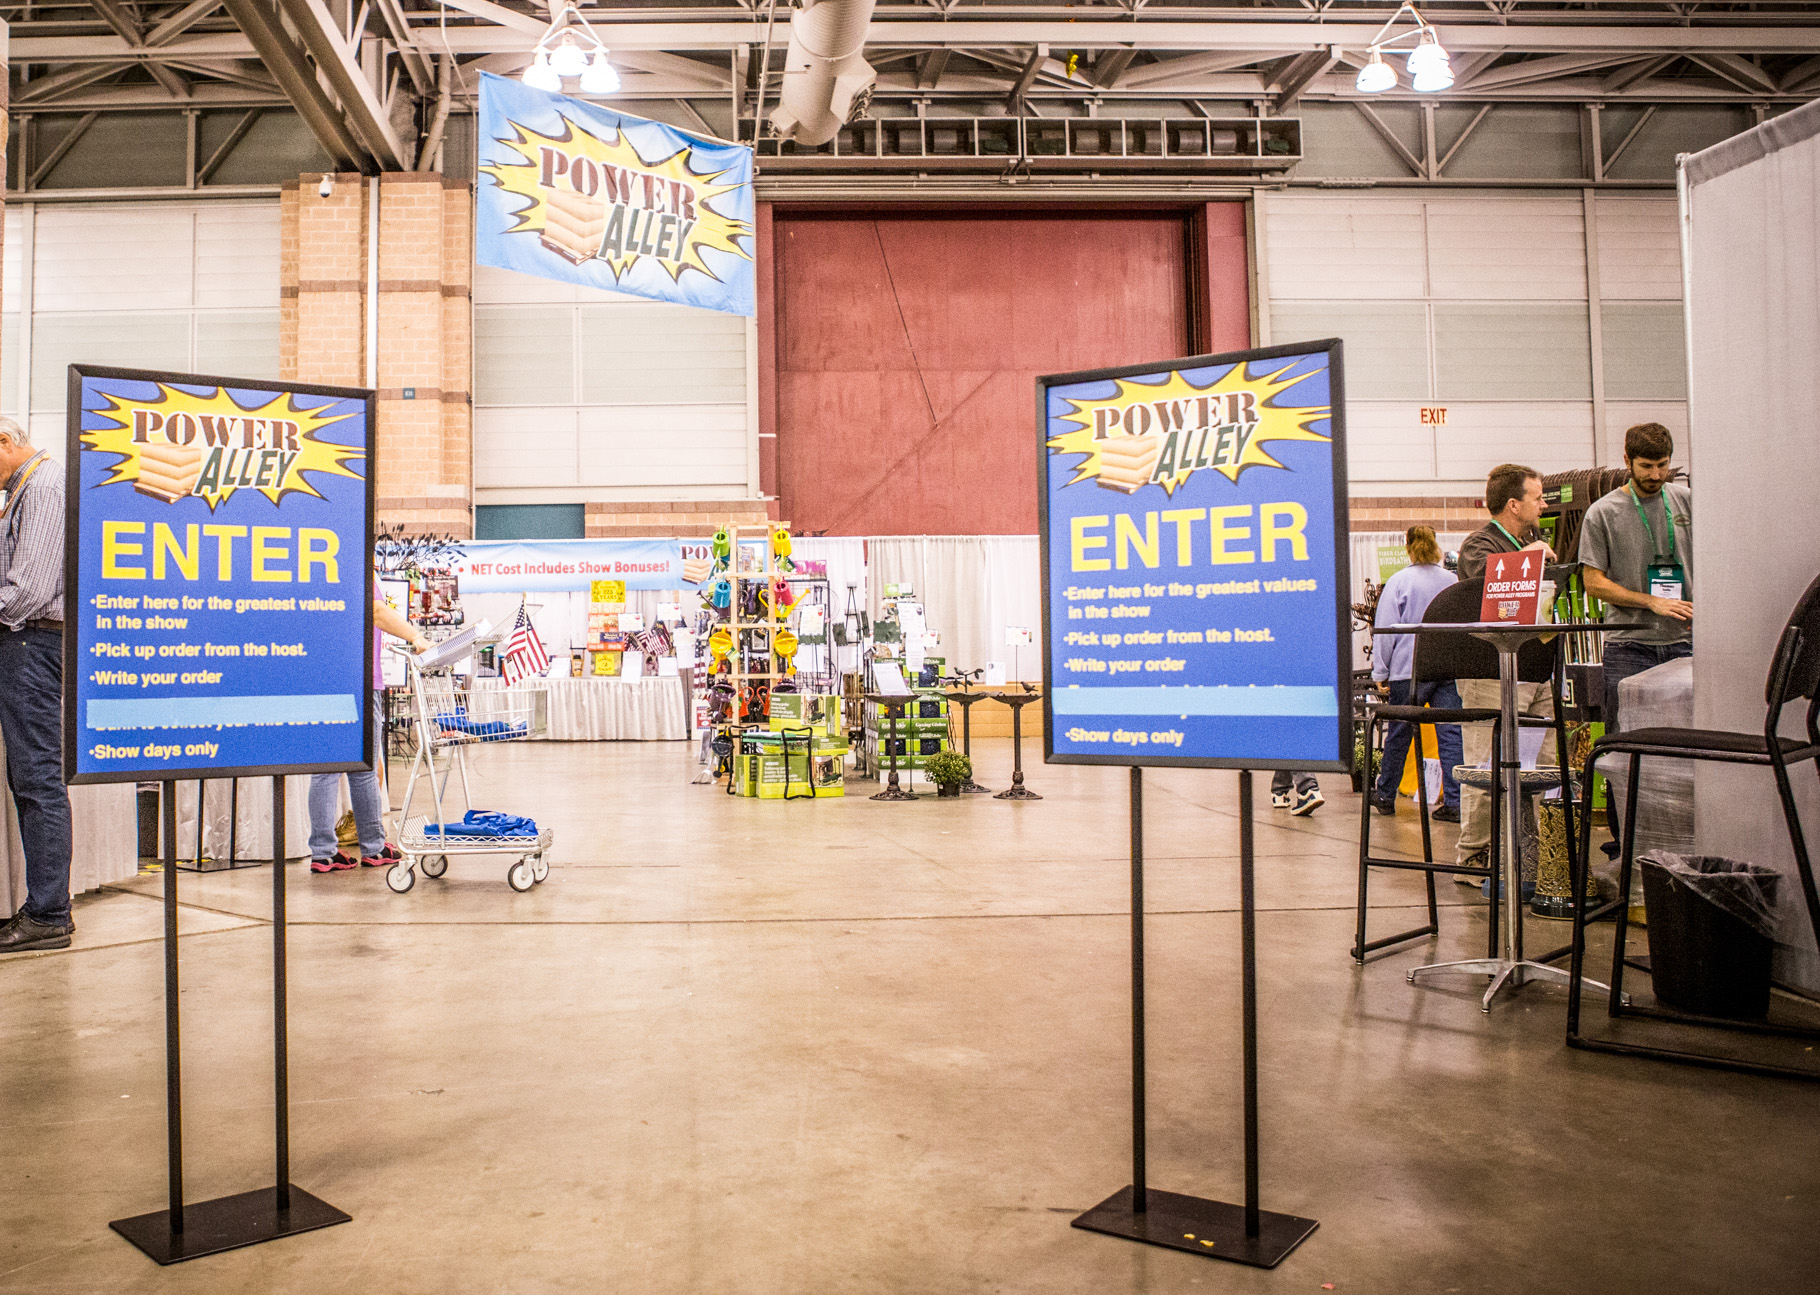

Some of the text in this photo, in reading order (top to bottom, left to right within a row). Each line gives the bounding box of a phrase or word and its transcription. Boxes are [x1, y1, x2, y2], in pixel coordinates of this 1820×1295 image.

[539, 146, 697, 221] POWER
[598, 203, 694, 262] ALLEY
[1093, 391, 1260, 440] POWER
[1420, 407, 1447, 424] EXIT
[132, 410, 301, 451] POWER
[1152, 422, 1256, 483] ALLEY
[192, 446, 298, 496] ALLEY
[1070, 501, 1310, 573] ENTER
[101, 520, 341, 584] ENTER
[471, 560, 670, 575] NET Cost Includes Show Bonuses!
[1108, 584, 1142, 600] here
[1144, 583, 1165, 598] for
[1168, 581, 1194, 597] the
[1196, 578, 1261, 599] greatest
[1263, 577, 1318, 593] values
[1487, 580, 1536, 593] ORDER FORMS
[143, 595, 179, 611] here
[182, 595, 204, 611] for
[207, 596, 233, 611] the
[235, 597, 296, 614] greatest
[299, 597, 346, 611] values
[1068, 604, 1151, 619] in the show
[97, 614, 188, 629] in the show
[1102, 633, 1122, 648] up
[1124, 630, 1164, 645] order
[1166, 629, 1203, 644] from
[1205, 628, 1232, 643] the
[1234, 627, 1275, 643] host.
[134, 646, 155, 660] up
[159, 643, 200, 657] order
[204, 643, 240, 657] from
[243, 643, 268, 657] the
[271, 642, 308, 656] host.
[1109, 659, 1143, 675] your
[1145, 657, 1186, 672] order
[141, 672, 178, 688] your
[181, 669, 223, 684] order
[1112, 728, 1149, 746] days
[1150, 729, 1185, 747] only
[143, 743, 181, 760] days
[185, 741, 219, 758] only
